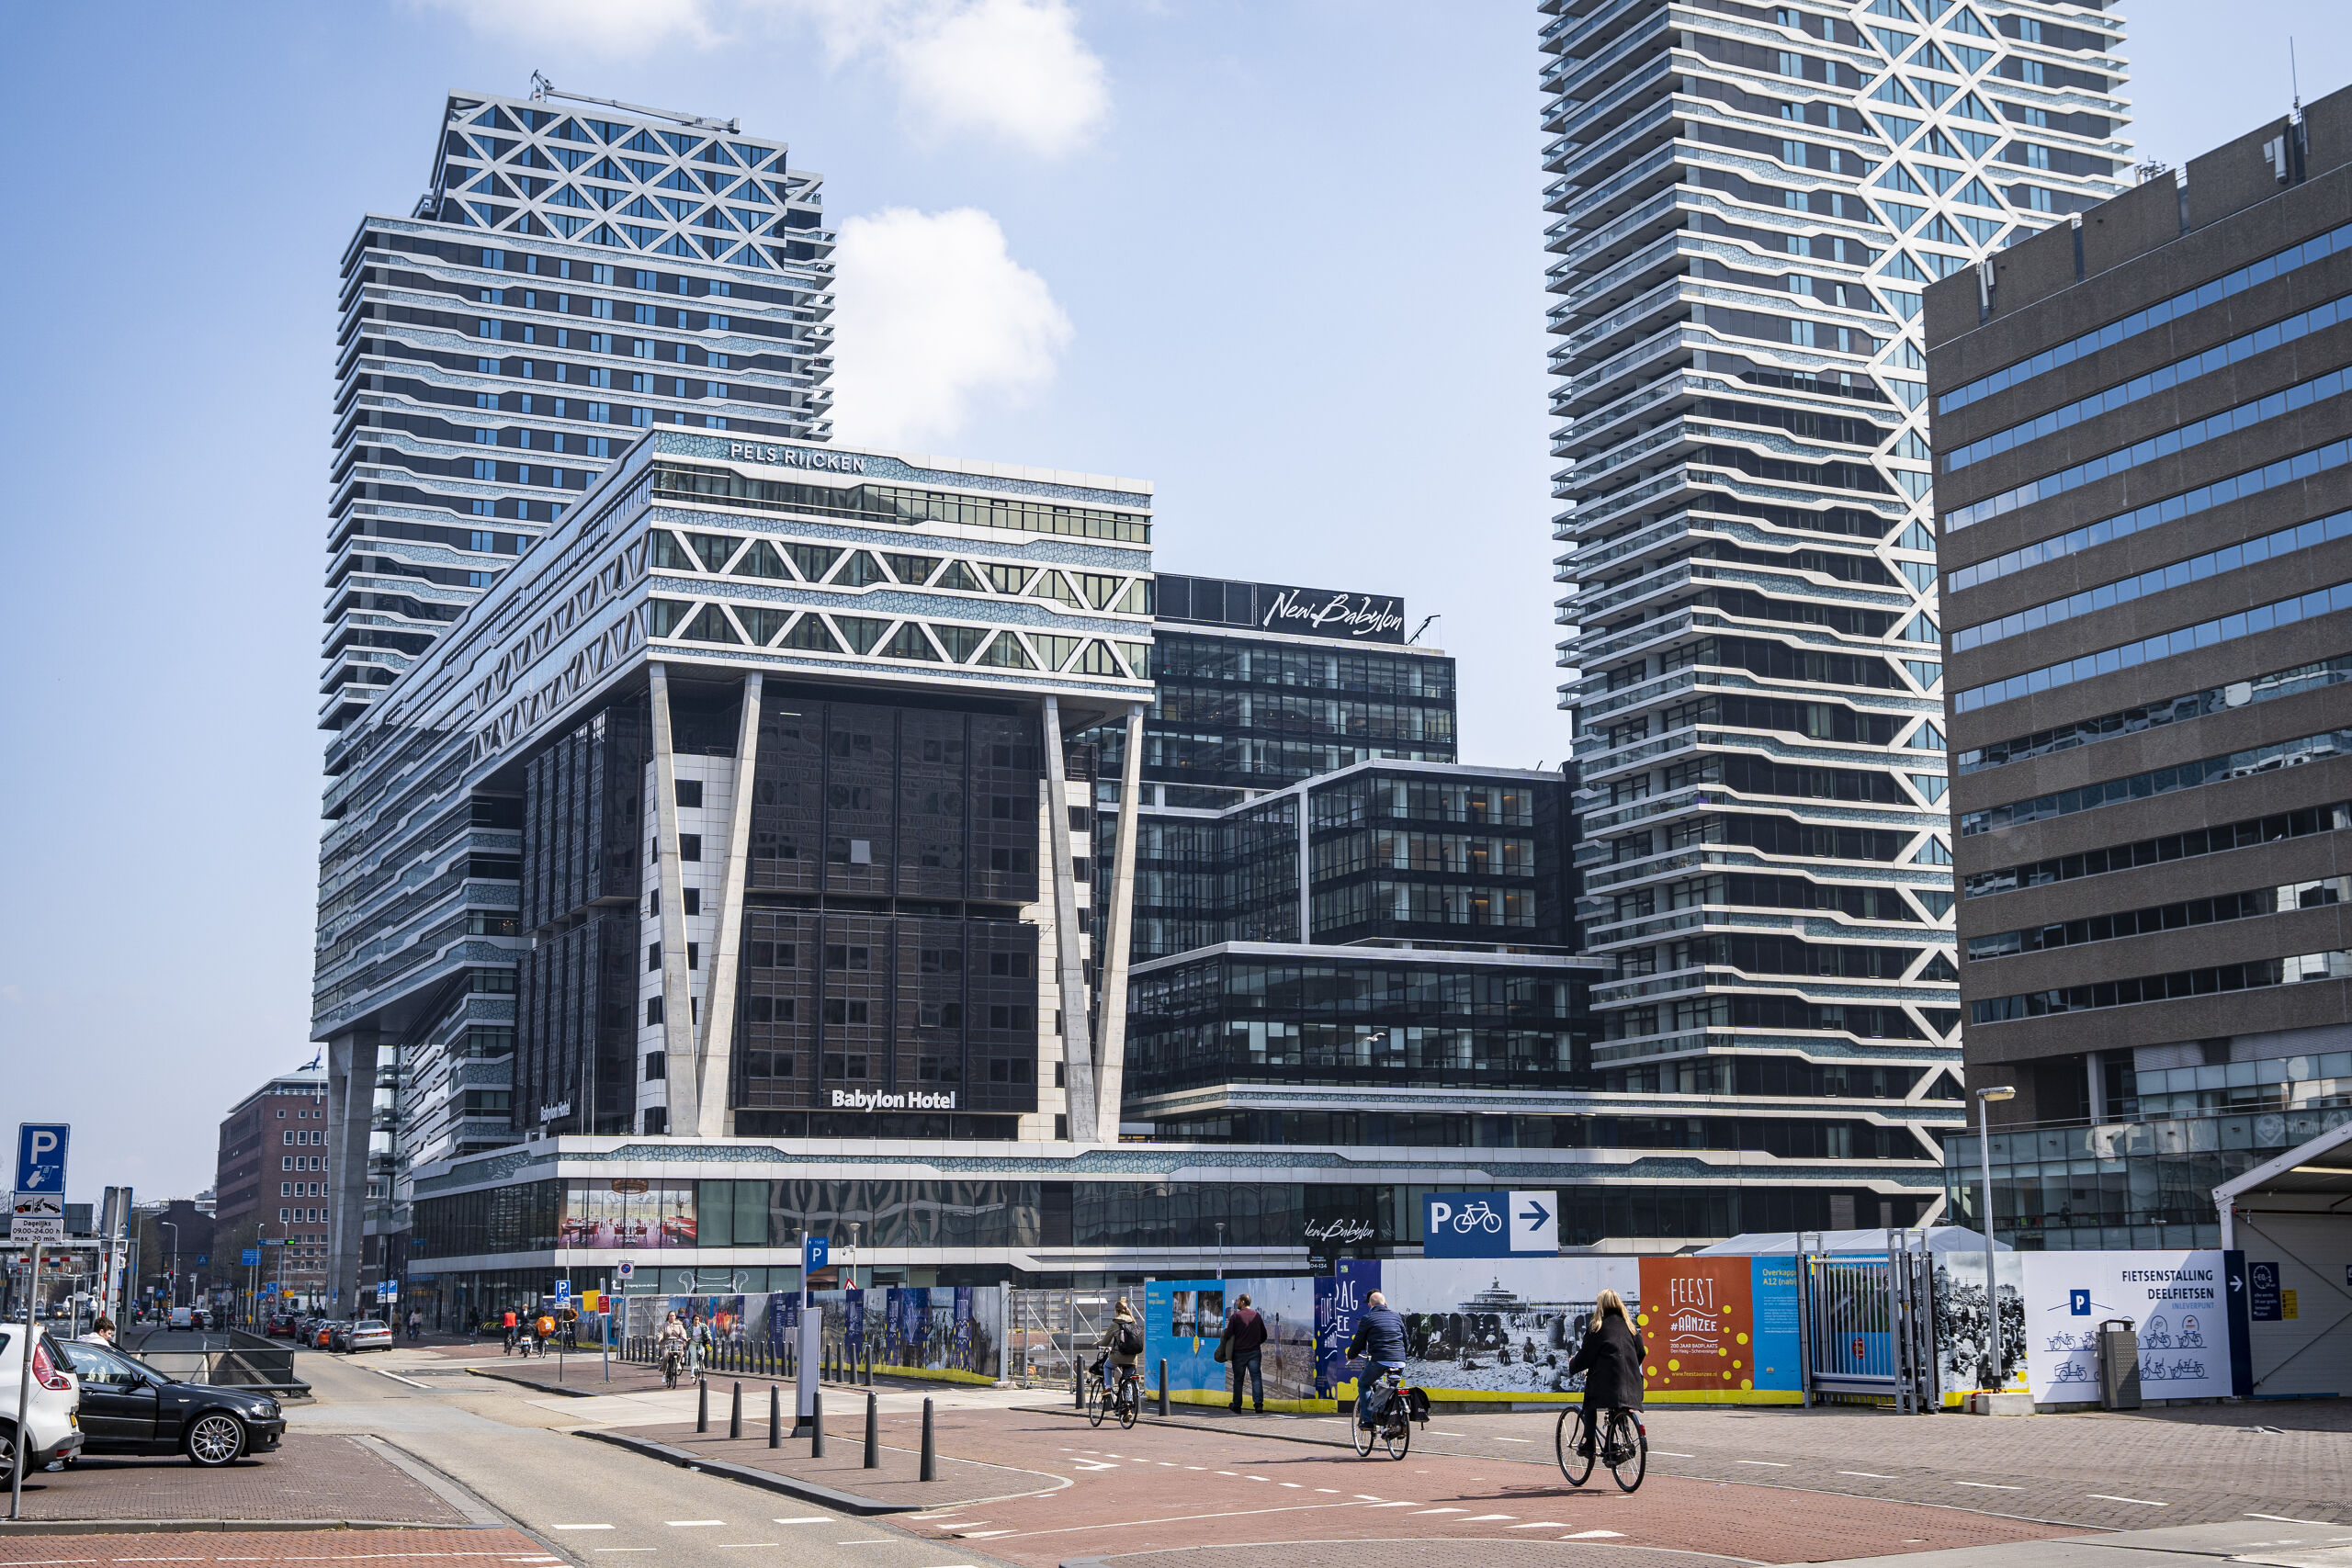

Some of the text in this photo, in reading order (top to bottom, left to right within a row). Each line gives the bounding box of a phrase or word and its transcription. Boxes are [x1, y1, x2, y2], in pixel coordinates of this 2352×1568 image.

[730, 443, 776, 462] PELS
[1262, 589, 1403, 635] New Babylon
[831, 1089, 956, 1112] Babylon Hotel
[30, 1131, 58, 1164] P
[23, 1220, 51, 1228] Dagelijks
[1430, 1202, 1452, 1233] P
[1321, 1218, 1374, 1243] Babylon
[812, 1247, 822, 1262] P
[2121, 1269, 2213, 1281] FIETSENSTALLING
[559, 1281, 567, 1293] P
[1670, 1278, 1713, 1309] FEEST
[2148, 1288, 2214, 1300] DEELFIETSEN
[2076, 1295, 2085, 1310] P
[2171, 1302, 2214, 1310] INLEVERPUNT
[1670, 1314, 1717, 1332] #AANZEE
